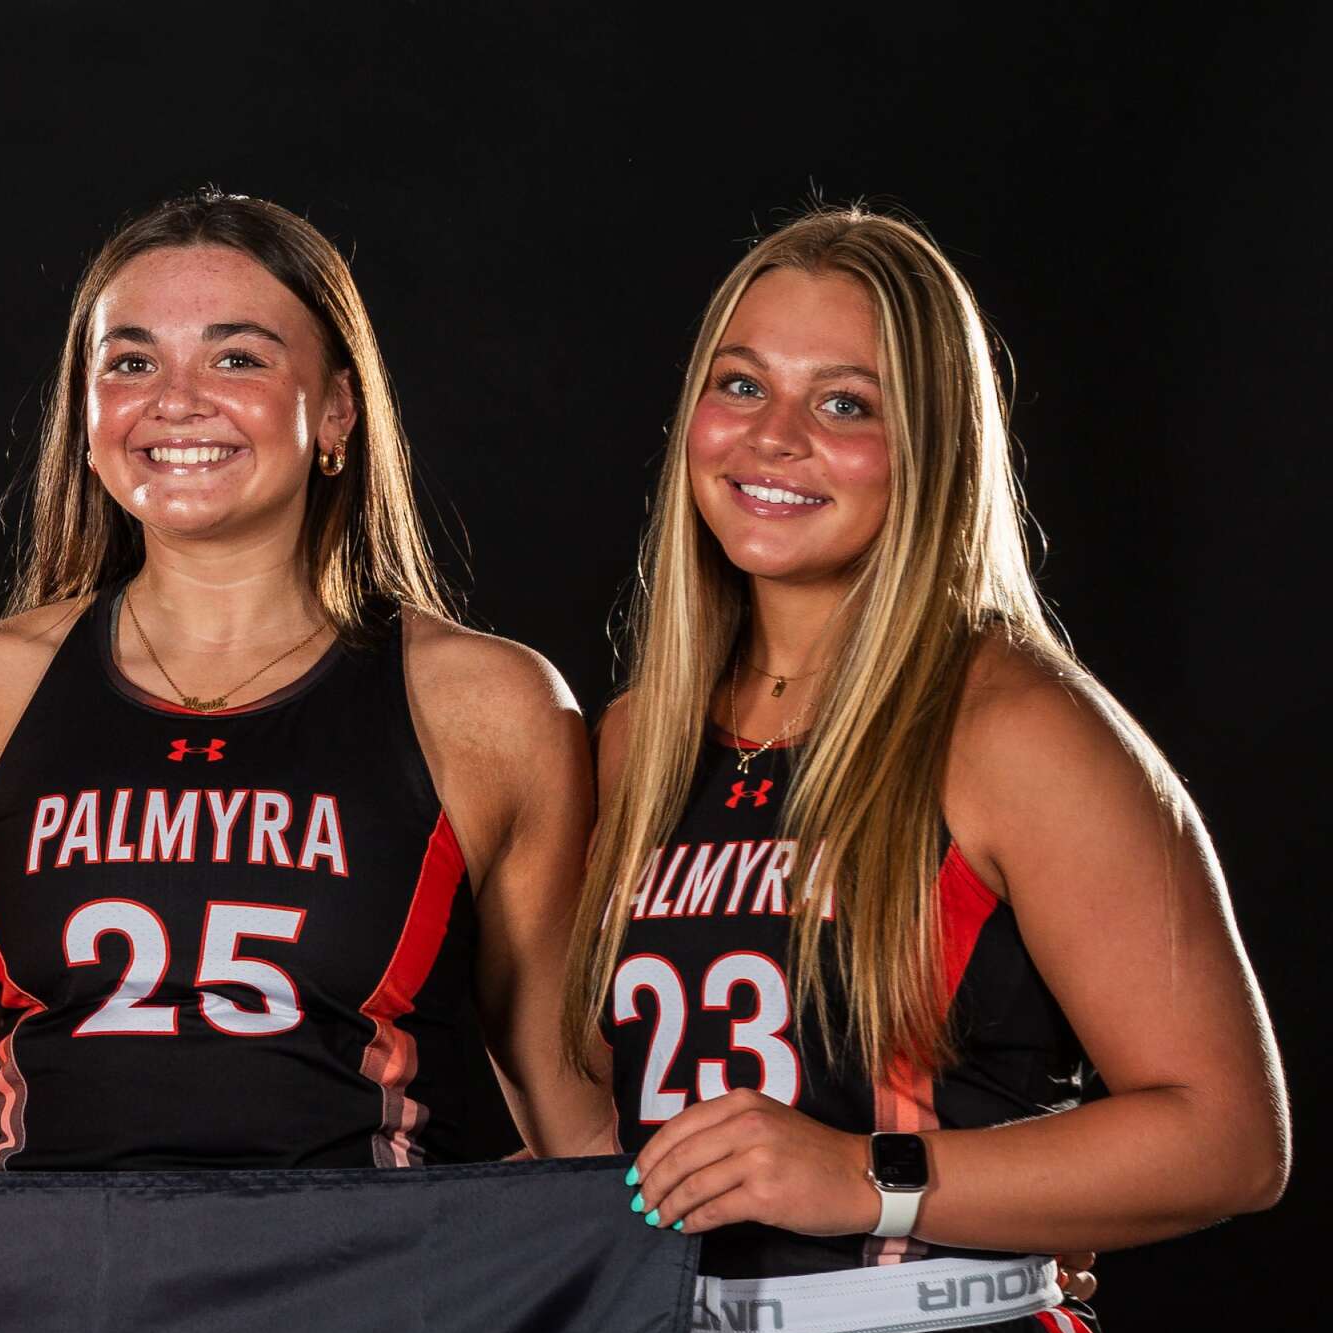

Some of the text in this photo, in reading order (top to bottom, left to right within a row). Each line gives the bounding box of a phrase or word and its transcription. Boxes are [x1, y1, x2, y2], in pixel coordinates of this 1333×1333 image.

[26, 788, 349, 877] PALMYRA
[63, 898, 307, 1037] 25
[613, 950, 801, 1125] 23
